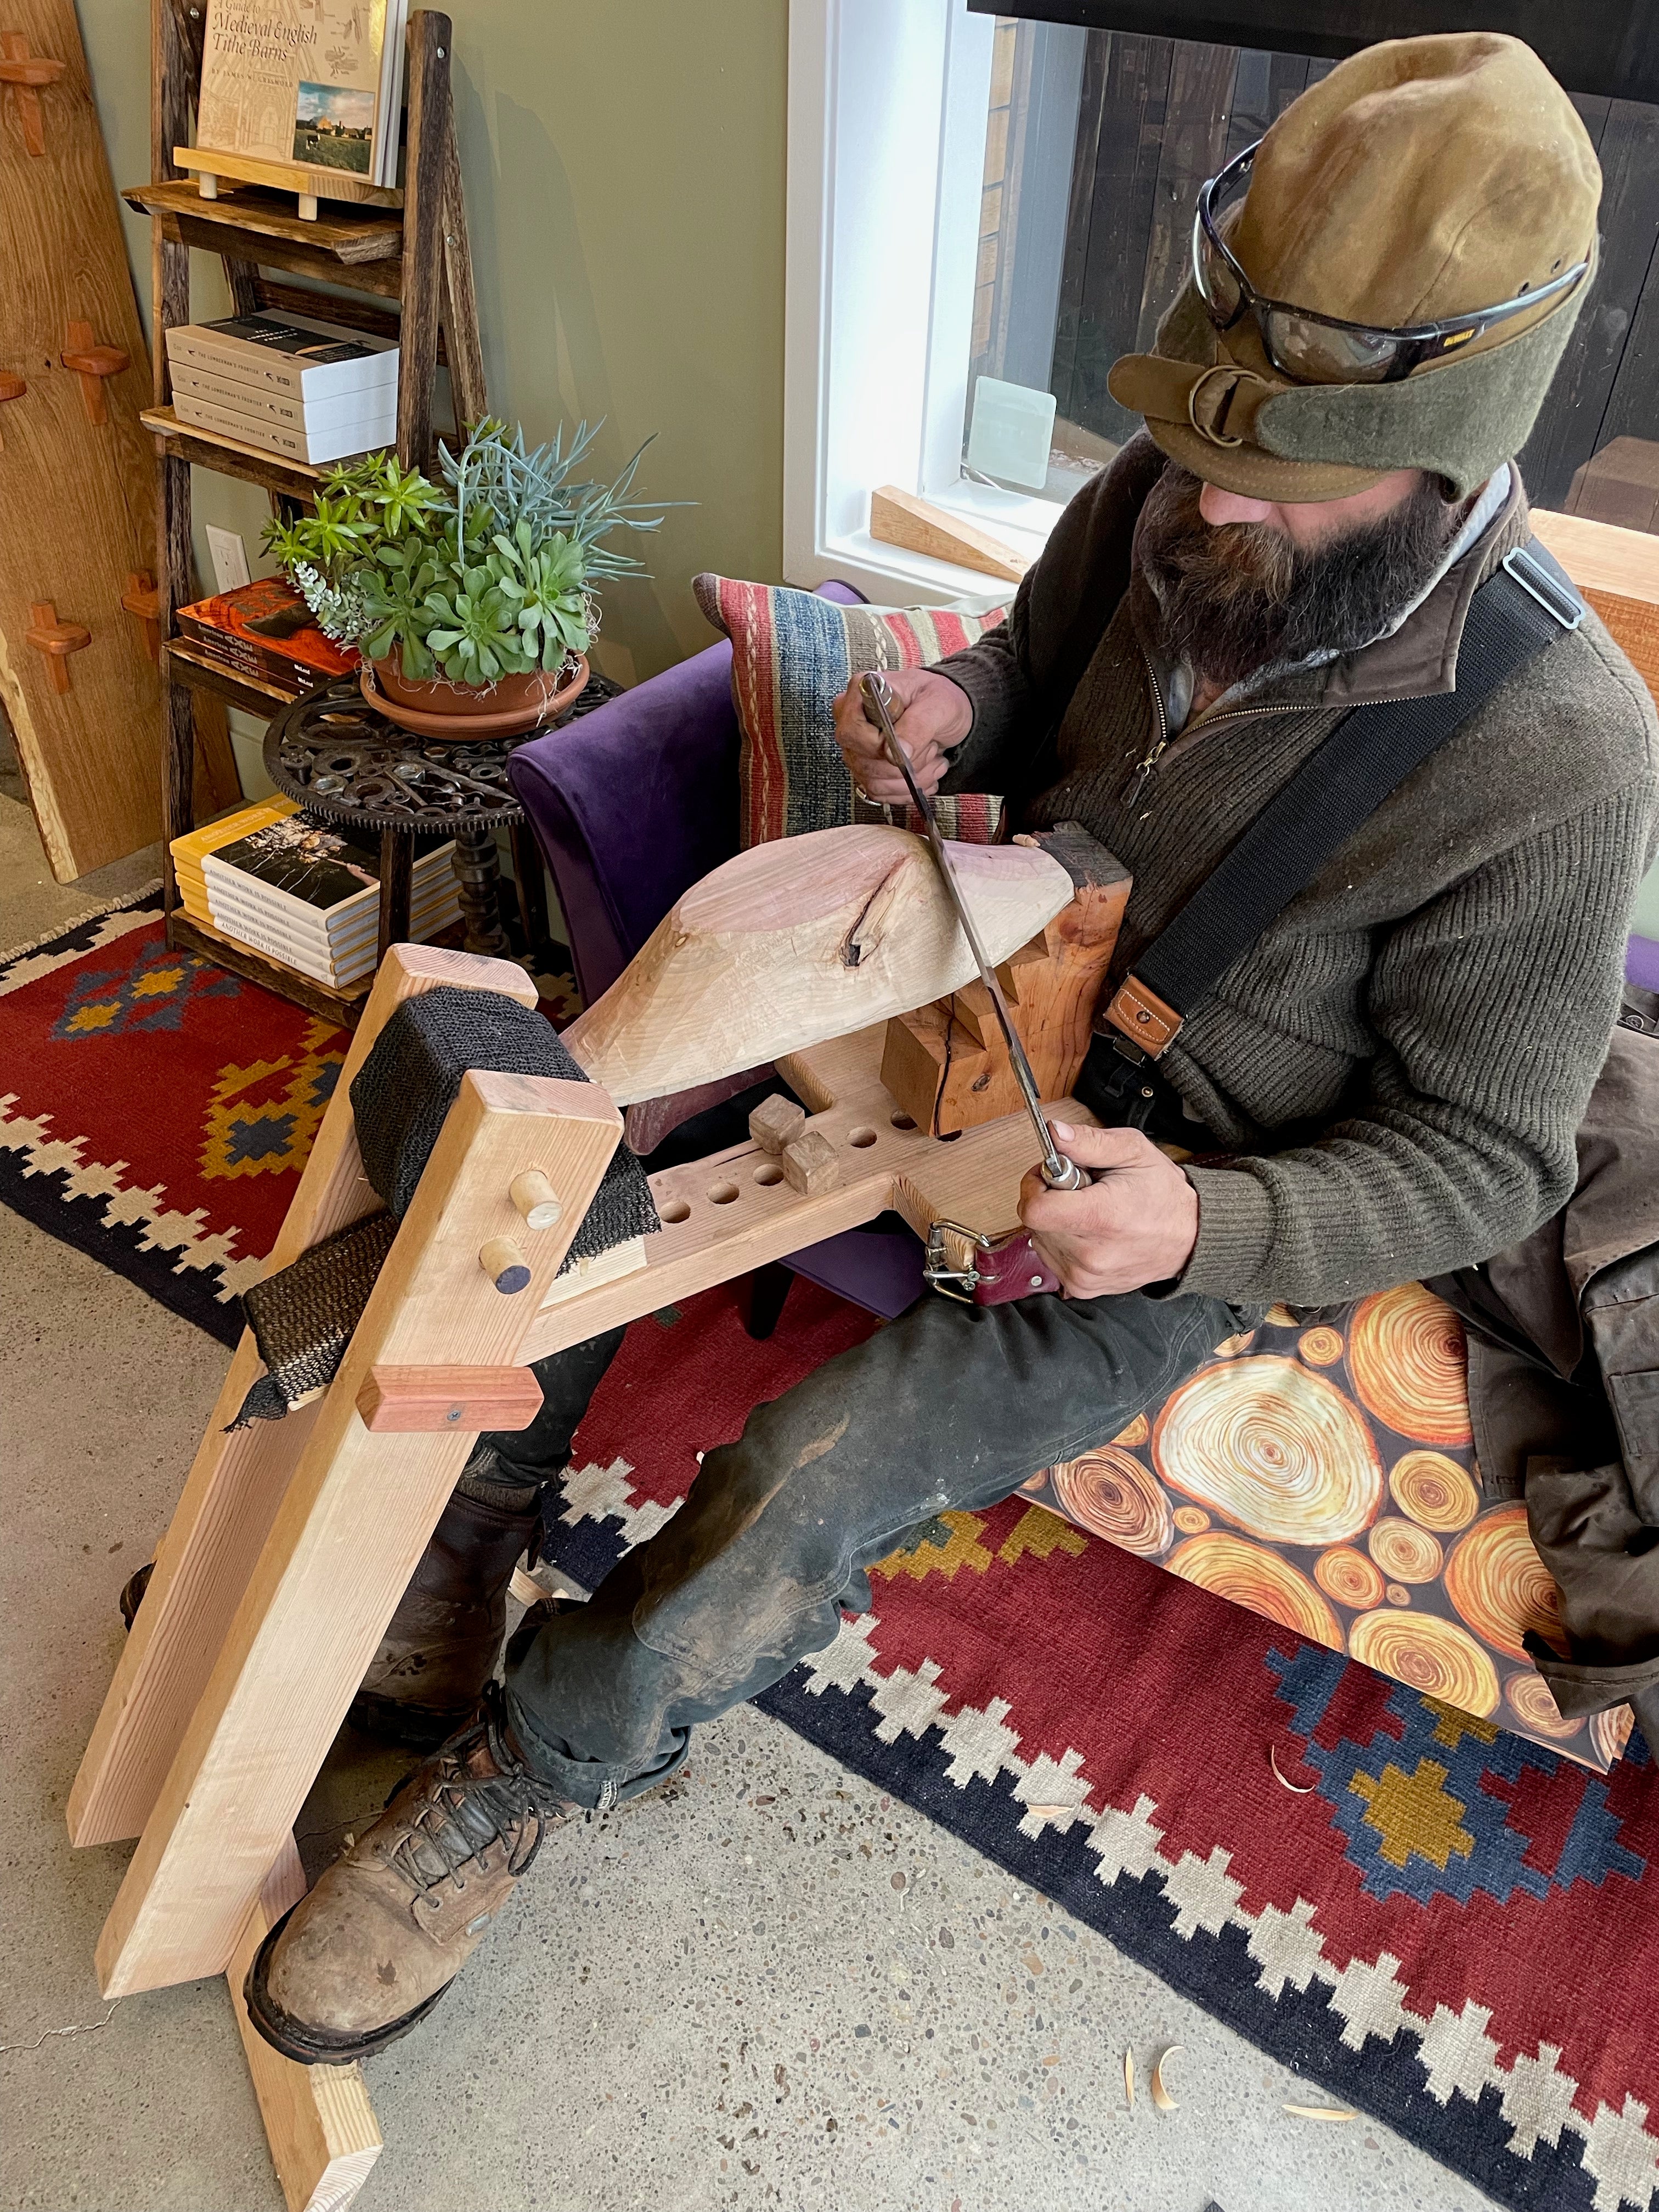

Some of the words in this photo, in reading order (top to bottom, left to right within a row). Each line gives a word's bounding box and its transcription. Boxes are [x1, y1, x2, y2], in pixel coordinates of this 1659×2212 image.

[225, 0, 250, 13] Guide
[252, 4, 261, 14] to
[212, 12, 272, 37] Medieval
[274, 21, 317, 47] English
[213, 32, 246, 55] Tithe
[249, 38, 288, 61] Barns
[223, 70, 244, 80] JAMES
[238, 363, 259, 375] FRONTIER
[241, 396, 262, 407] FRONTIER
[245, 426, 265, 438] FRONTIER
[224, 635, 253, 652] AXE
[229, 647, 257, 664] AXE
[230, 660, 259, 678] AXE
[210, 870, 236, 886] ANOTHER
[237, 883, 253, 894] WORK
[261, 894, 287, 911] POSSIBLE
[213, 885, 239, 901] ANOTHER
[240, 898, 256, 911] WORK
[264, 910, 290, 926] POSSIBLE
[215, 899, 241, 915] ANOTHER
[242, 912, 258, 926] WORK
[267, 924, 292, 940] POSSIBLE
[217, 912, 242, 929] ANOTHER
[244, 926, 260, 938] WORK
[268, 936, 292, 953] POSSIBLE
[222, 922, 247, 940] ANOTHER
[249, 936, 264, 949] WORK
[272, 948, 298, 966] POSSIBLE
